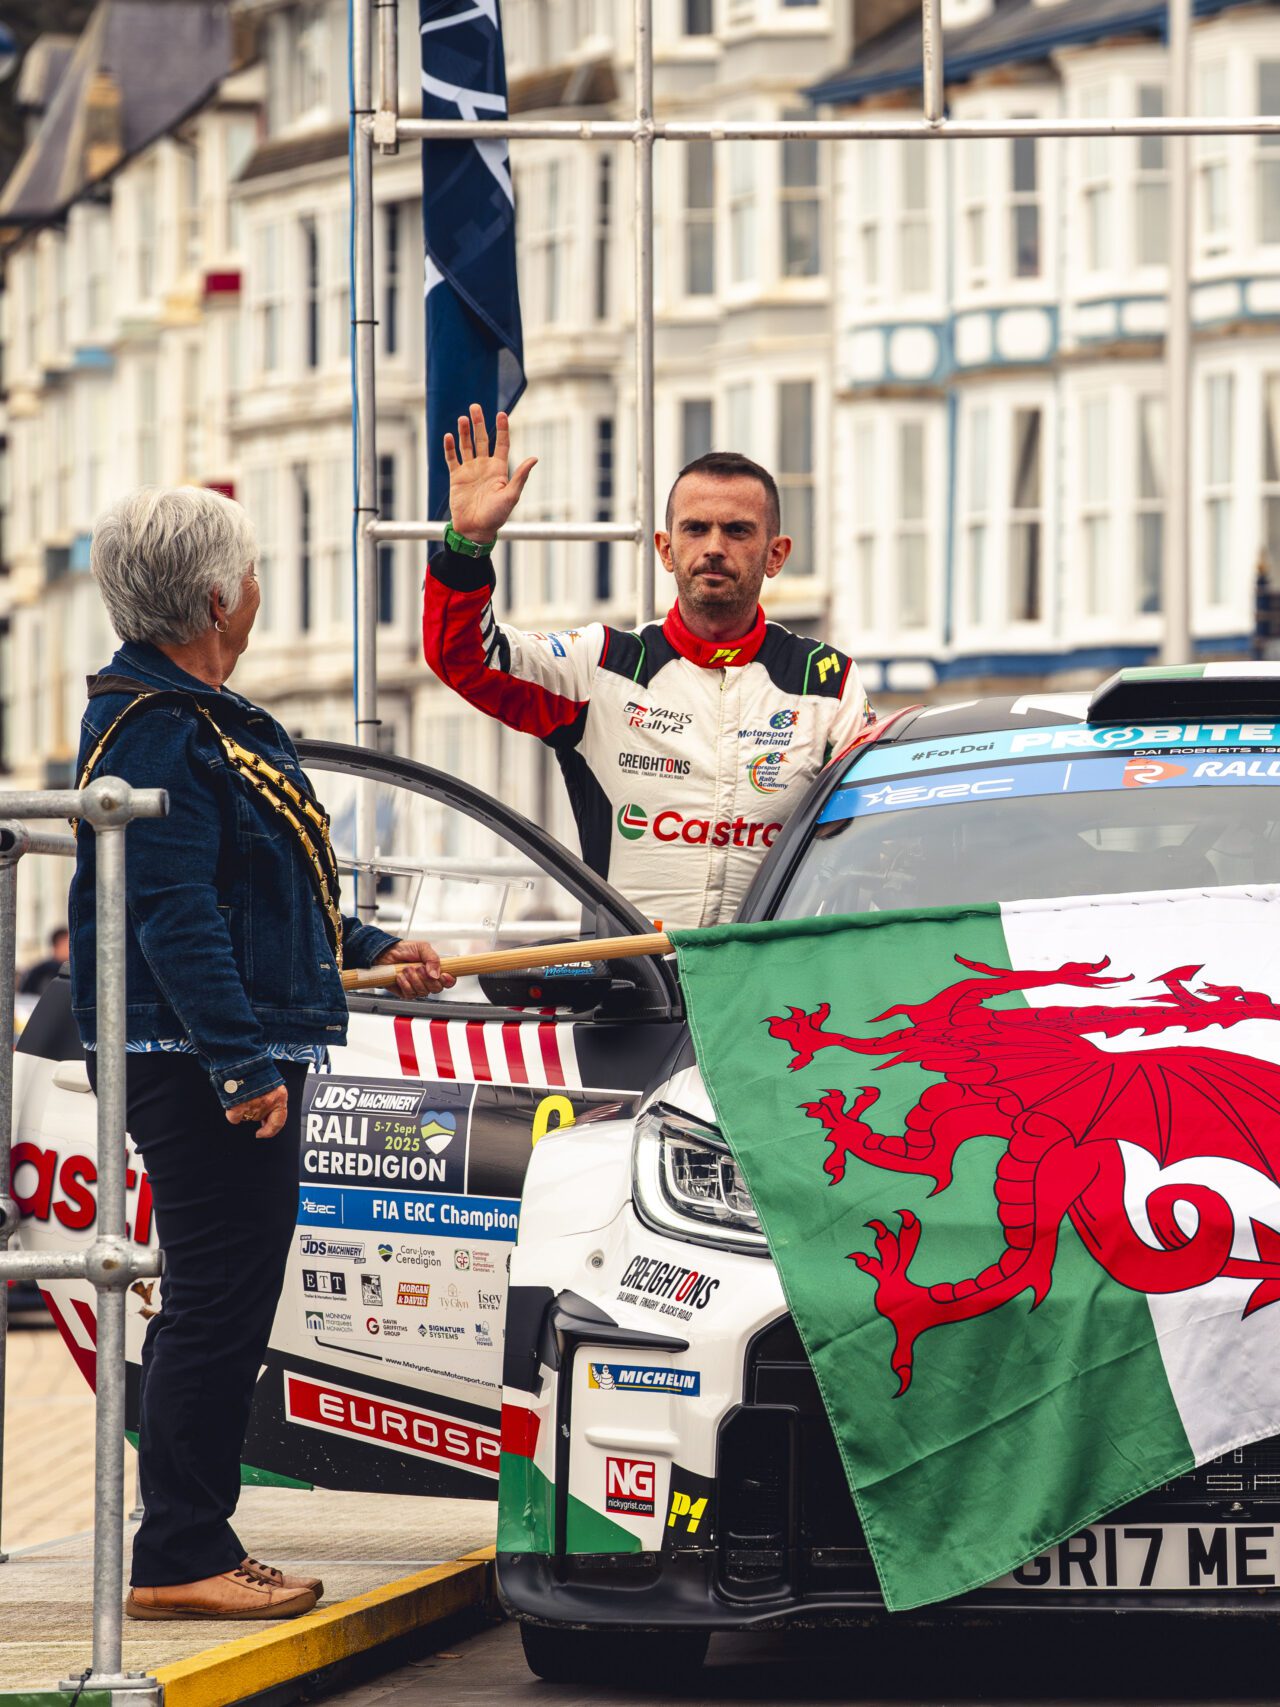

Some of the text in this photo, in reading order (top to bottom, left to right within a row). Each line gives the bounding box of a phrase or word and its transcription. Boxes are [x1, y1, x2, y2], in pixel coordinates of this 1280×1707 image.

[708, 648, 742, 664] P1
[816, 653, 840, 683] P1
[629, 717, 684, 734] Rally2
[738, 730, 793, 738] Motorsport
[755, 738, 790, 746] Ireland
[1009, 724, 1276, 753] PROBITE
[912, 742, 995, 761] #ForDai
[1170, 747, 1251, 755] ROBERTS
[619, 753, 691, 774] CREIGHTONS
[885, 778, 1015, 804] ERC
[315, 1087, 420, 1111] JDS MACHINERY
[305, 1114, 368, 1146] RALI
[374, 1122, 417, 1135] 5-7 Sept
[385, 1137, 420, 1151] 2025
[304, 1150, 446, 1182] CEREDIGION
[372, 1200, 518, 1231] FIA ERC Champion
[303, 1241, 362, 1256] JDS MACHINERY
[396, 1253, 441, 1268] Ceredigion
[306, 1274, 342, 1289] ETT
[399, 1284, 429, 1294] MORGAN
[620, 1255, 720, 1310] CREIGHTONS
[404, 1296, 427, 1305] DAVIES
[659, 1303, 679, 1317] BLACKS
[678, 1308, 693, 1321] ROAD
[429, 1324, 465, 1333] SIGNATURE
[430, 1332, 458, 1340] SYSTEMS
[385, 1357, 496, 1388] www.MelvynEvansMotorsport.com
[618, 1370, 695, 1388] MICHELIN
[609, 1460, 653, 1498] NG
[608, 1499, 652, 1512] nickygrist.com
[667, 1491, 708, 1533] P1
[1012, 1528, 1163, 1586] GR17
